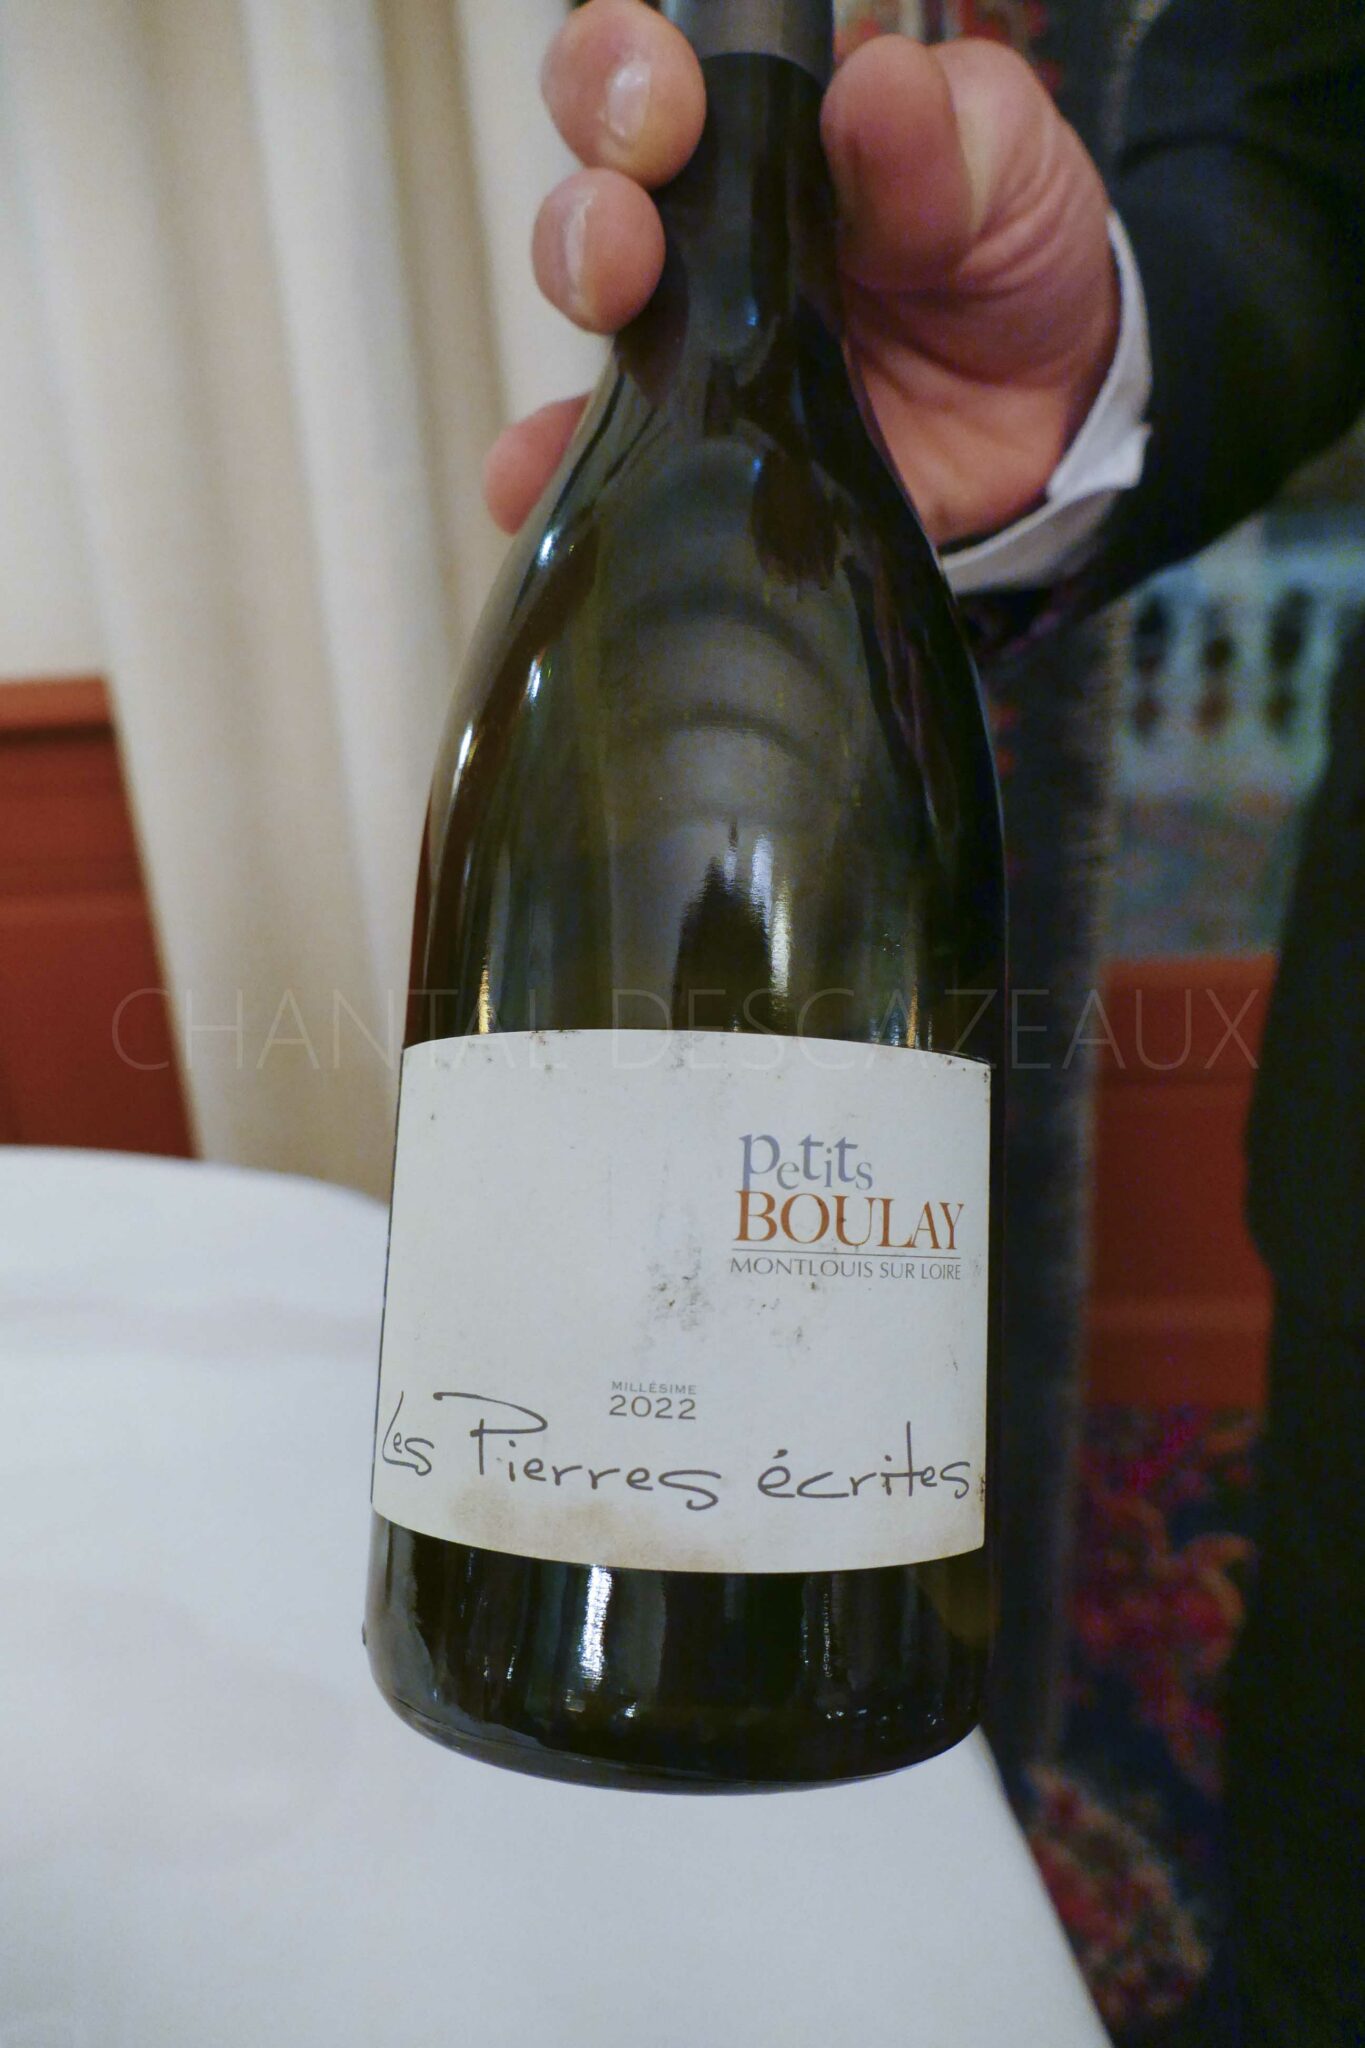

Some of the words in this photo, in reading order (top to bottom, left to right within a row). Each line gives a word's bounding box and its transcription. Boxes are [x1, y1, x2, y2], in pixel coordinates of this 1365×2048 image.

[734, 1189, 964, 1251] BOULAY
[730, 1256, 874, 1280] MONTLOUIS
[879, 1260, 915, 1280] SUR
[920, 1261, 962, 1281] LOIRE
[610, 1379, 698, 1396] MILLÉSIME
[608, 1395, 698, 1421] 2022
[382, 1390, 435, 1477] Les
[432, 1391, 721, 1511] Pierres
[757, 1421, 971, 1501] écrites
